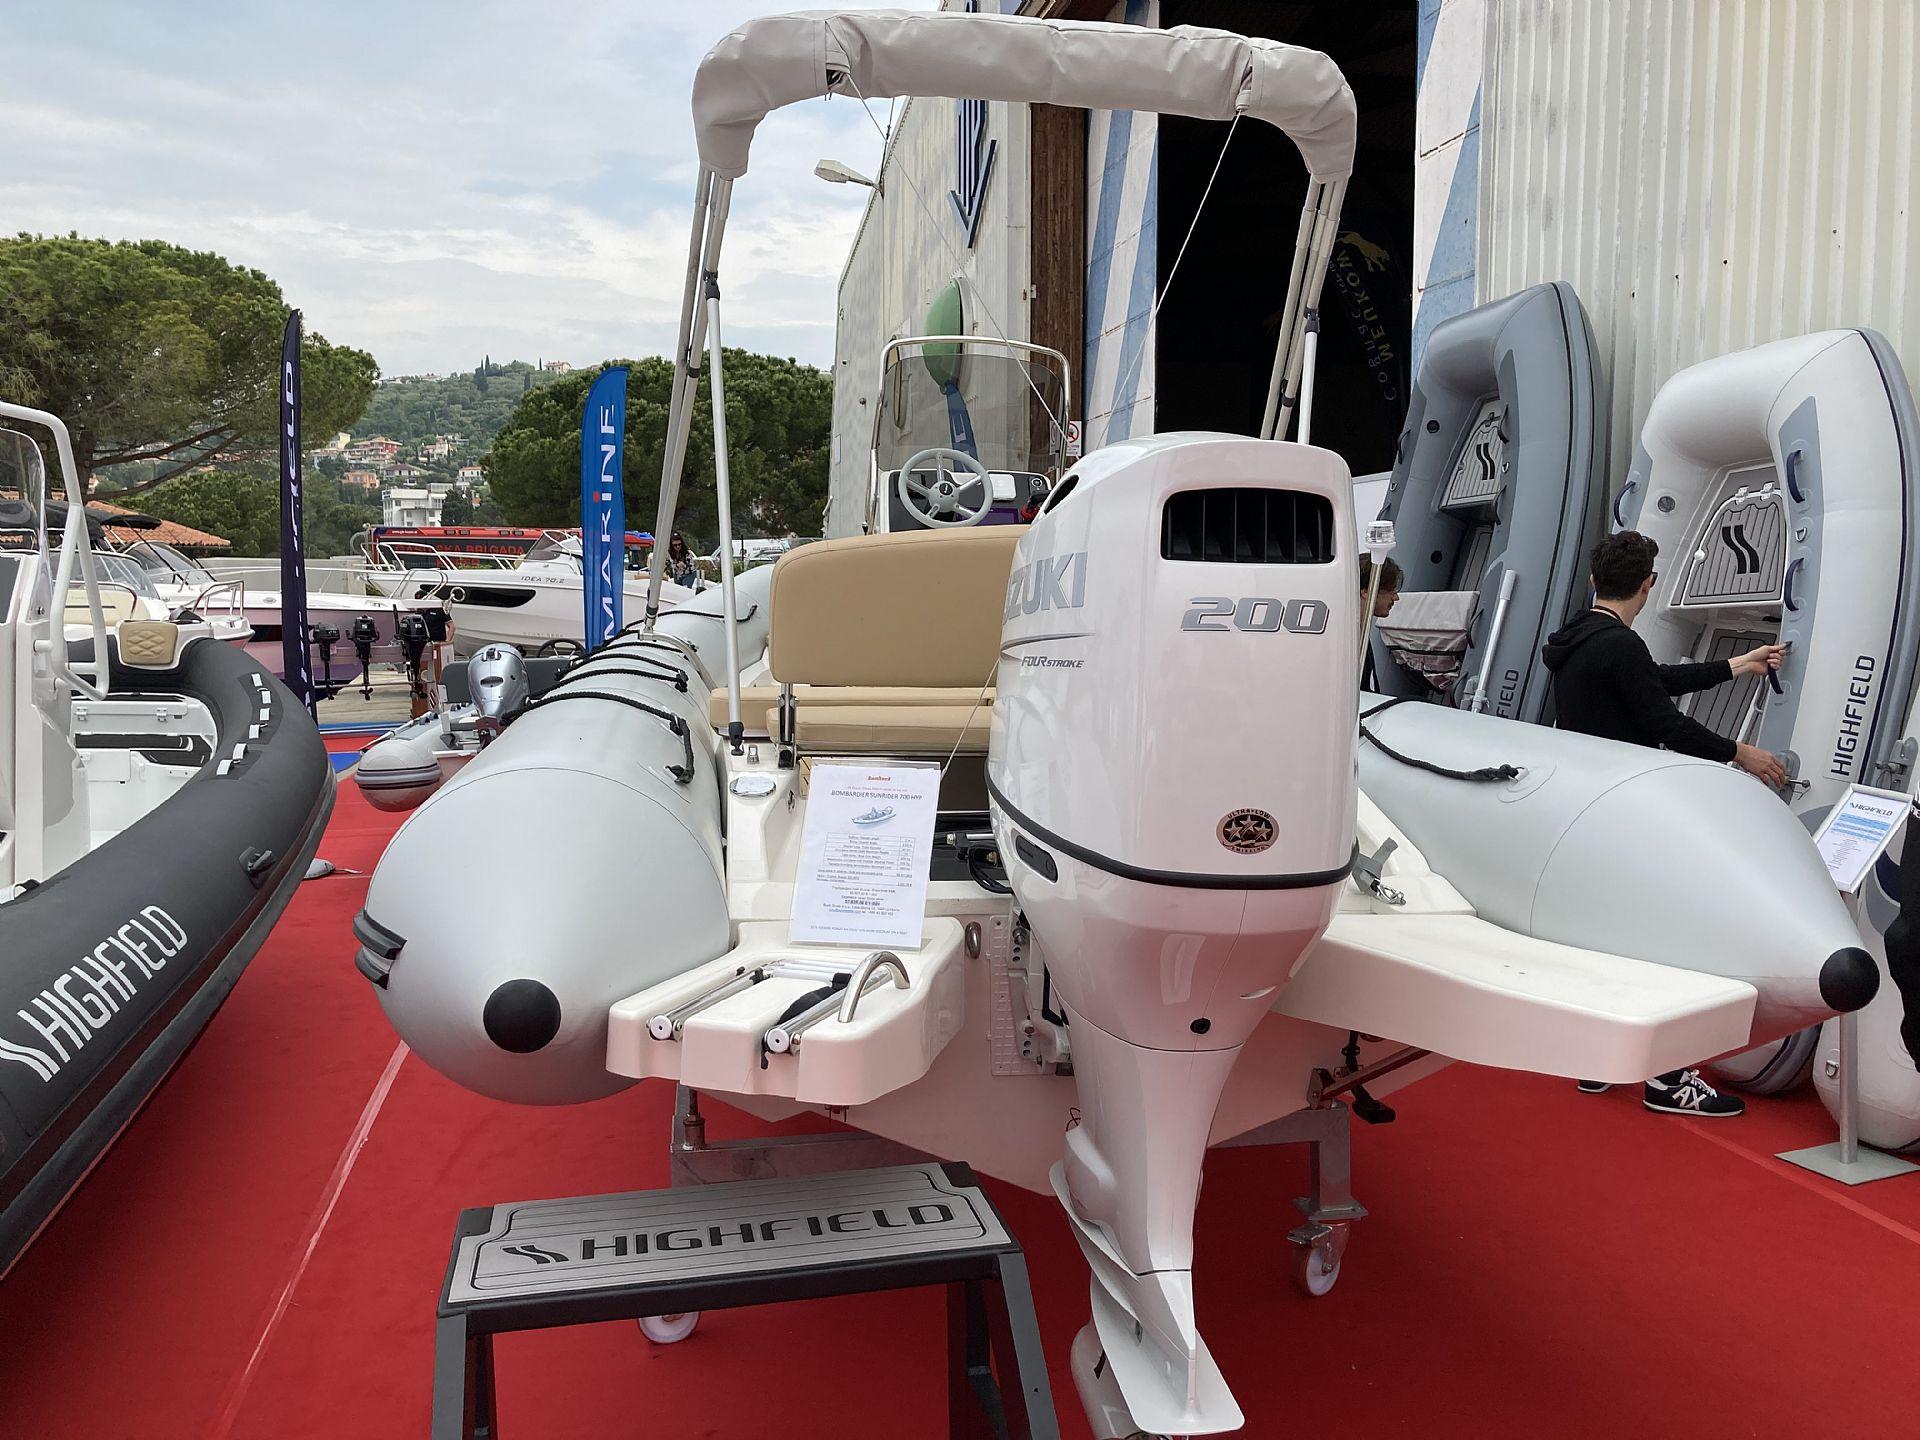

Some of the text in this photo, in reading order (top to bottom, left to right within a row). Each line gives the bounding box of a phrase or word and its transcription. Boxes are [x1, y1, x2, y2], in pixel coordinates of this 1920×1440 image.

[1002, 552, 1088, 626] ZUKI
[1180, 596, 1330, 635] 200
[1496, 669, 1519, 718] FIELD
[1830, 654, 1876, 777] HIGHFIELD
[870, 792, 899, 800] SUNRIDER
[1854, 803, 1894, 817] HIGHFIELD
[17, 905, 188, 1063] HIGHFIELD
[1671, 1085, 1707, 1111] AX
[581, 1202, 956, 1261] HIGHFIELD
